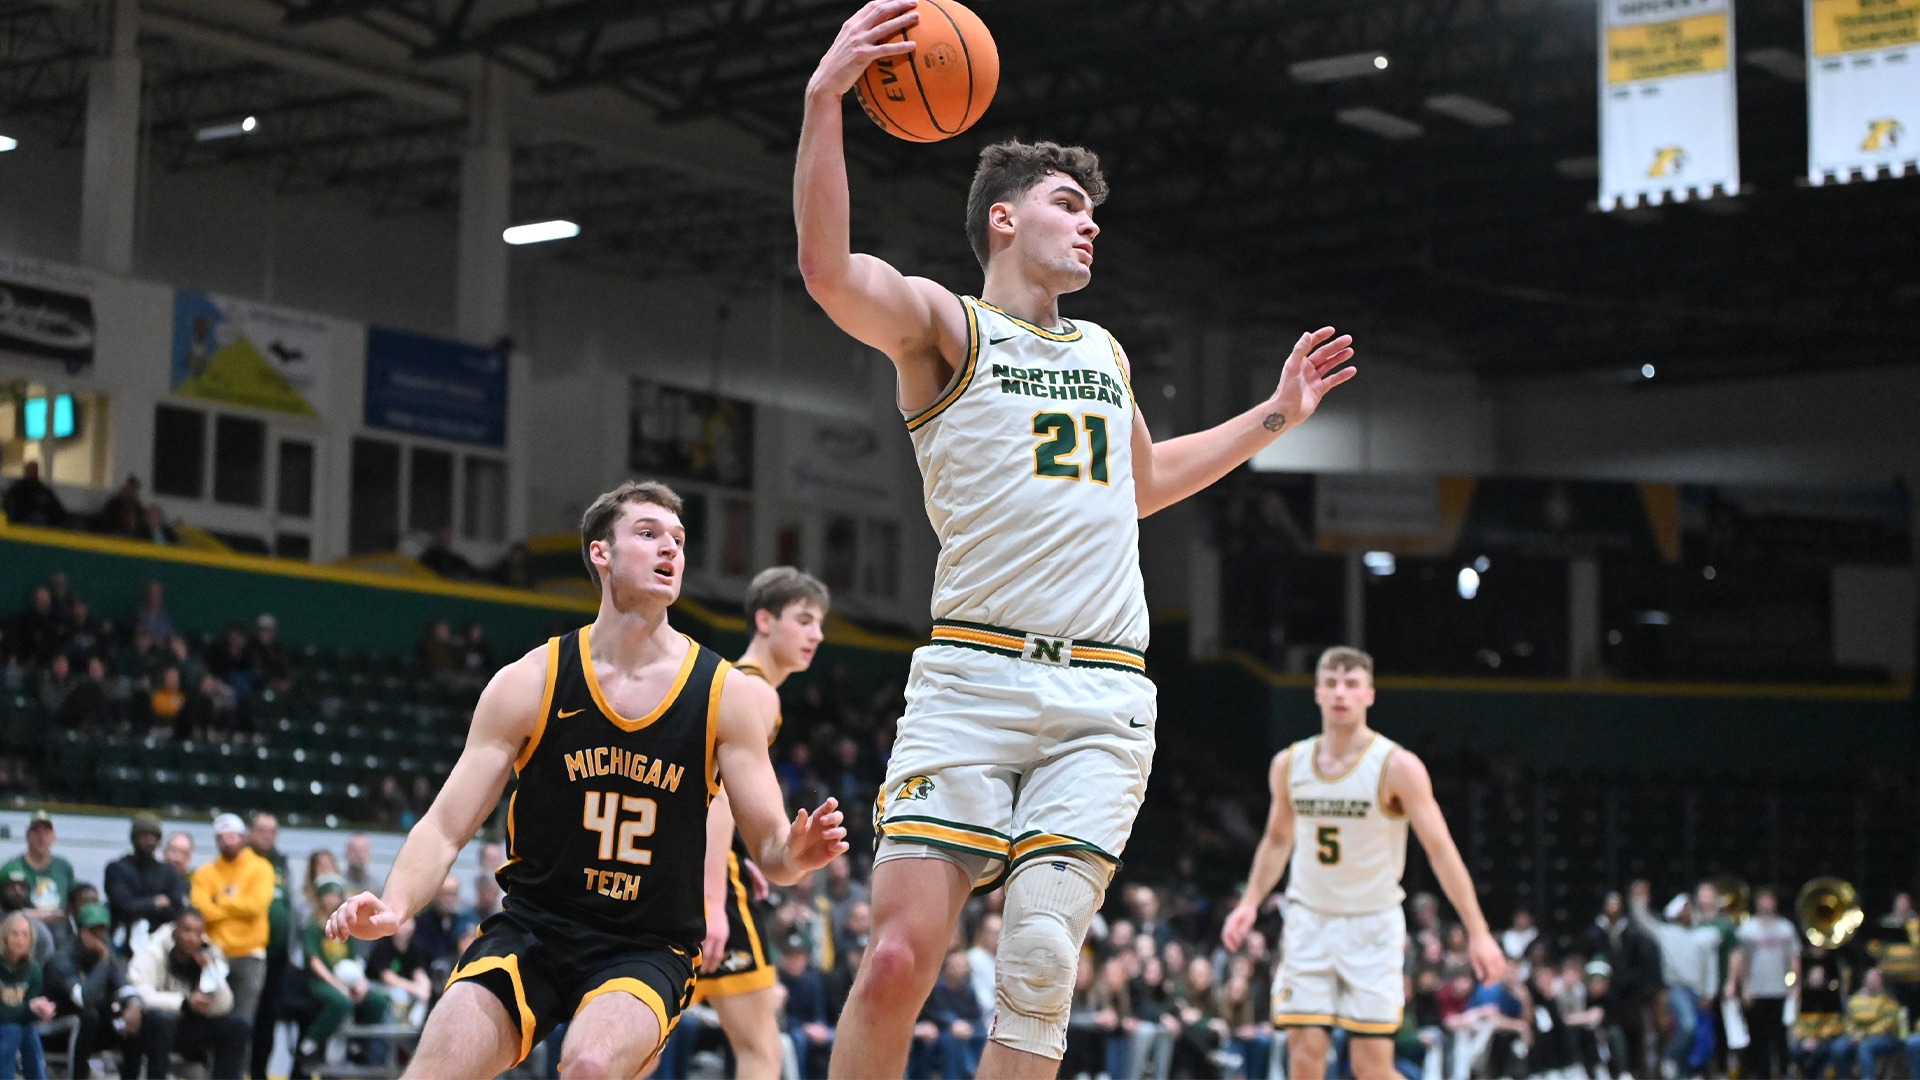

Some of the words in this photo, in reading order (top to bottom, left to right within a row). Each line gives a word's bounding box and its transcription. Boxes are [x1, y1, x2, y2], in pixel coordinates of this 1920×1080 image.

[992, 363, 1123, 396] NORTHERN
[1001, 380, 1123, 409] MICHIGAN
[1031, 411, 1110, 486] 21
[1032, 638, 1064, 663] N
[564, 746, 685, 793] MICHIGAN
[583, 791, 657, 866] 42
[1316, 825, 1341, 865] 5
[583, 868, 641, 901] TECH
